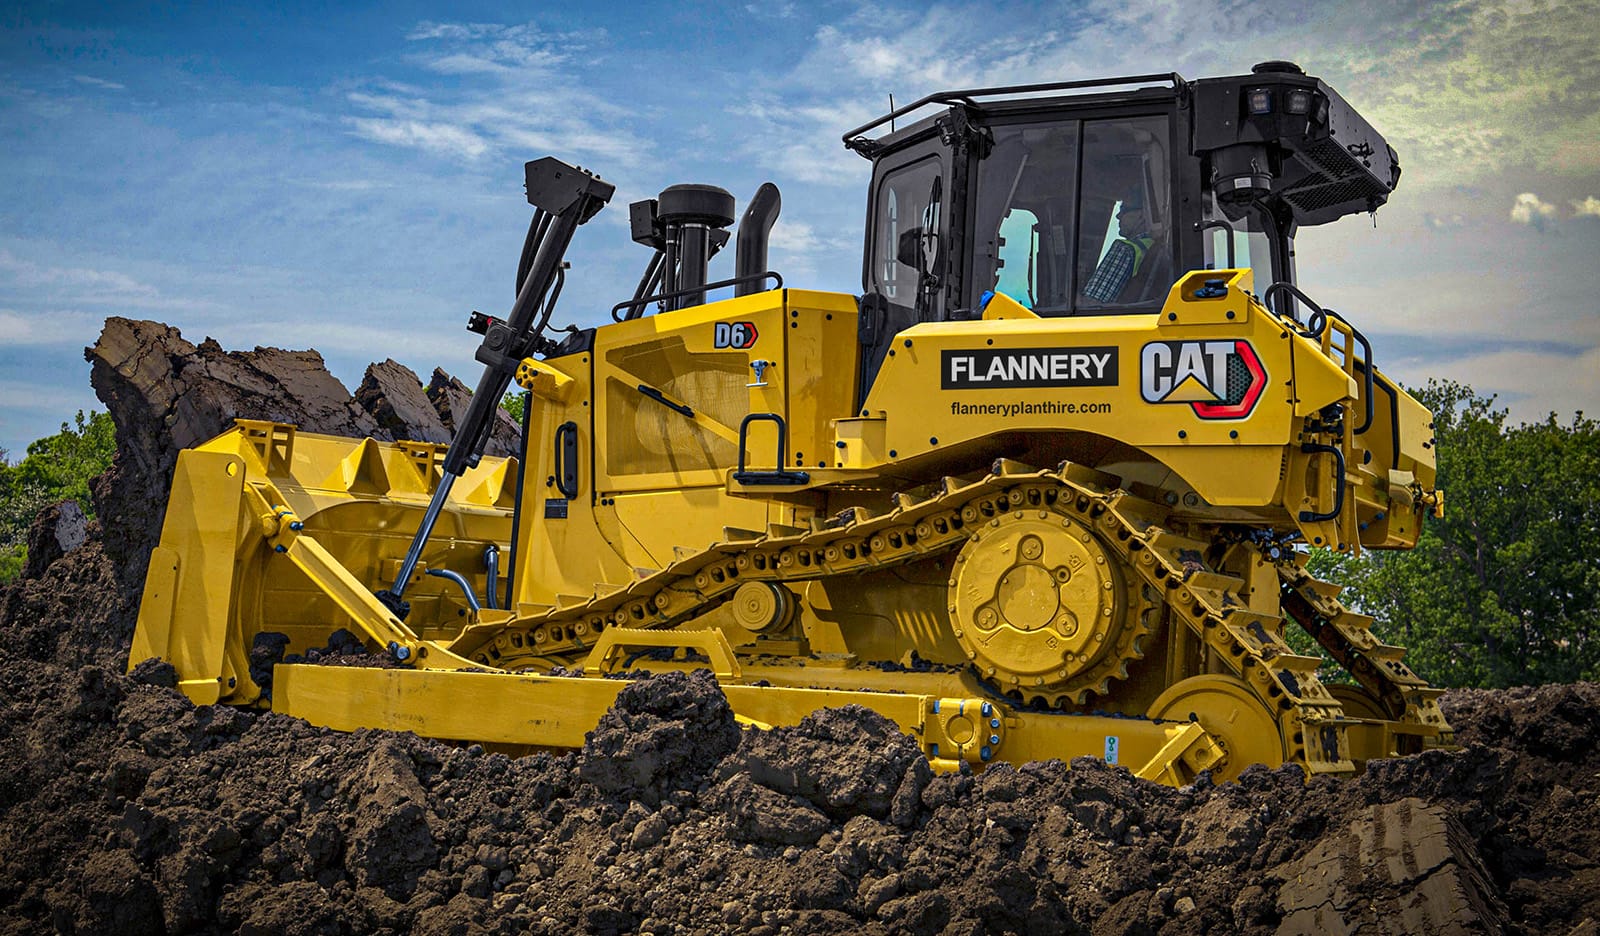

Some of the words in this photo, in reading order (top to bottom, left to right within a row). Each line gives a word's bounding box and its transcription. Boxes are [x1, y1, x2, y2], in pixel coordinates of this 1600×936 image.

[715, 323, 745, 348] D6
[951, 353, 1112, 382] FLANNERY
[1142, 341, 1235, 402] CAT
[950, 401, 1112, 417] flanneryplanthire.com
